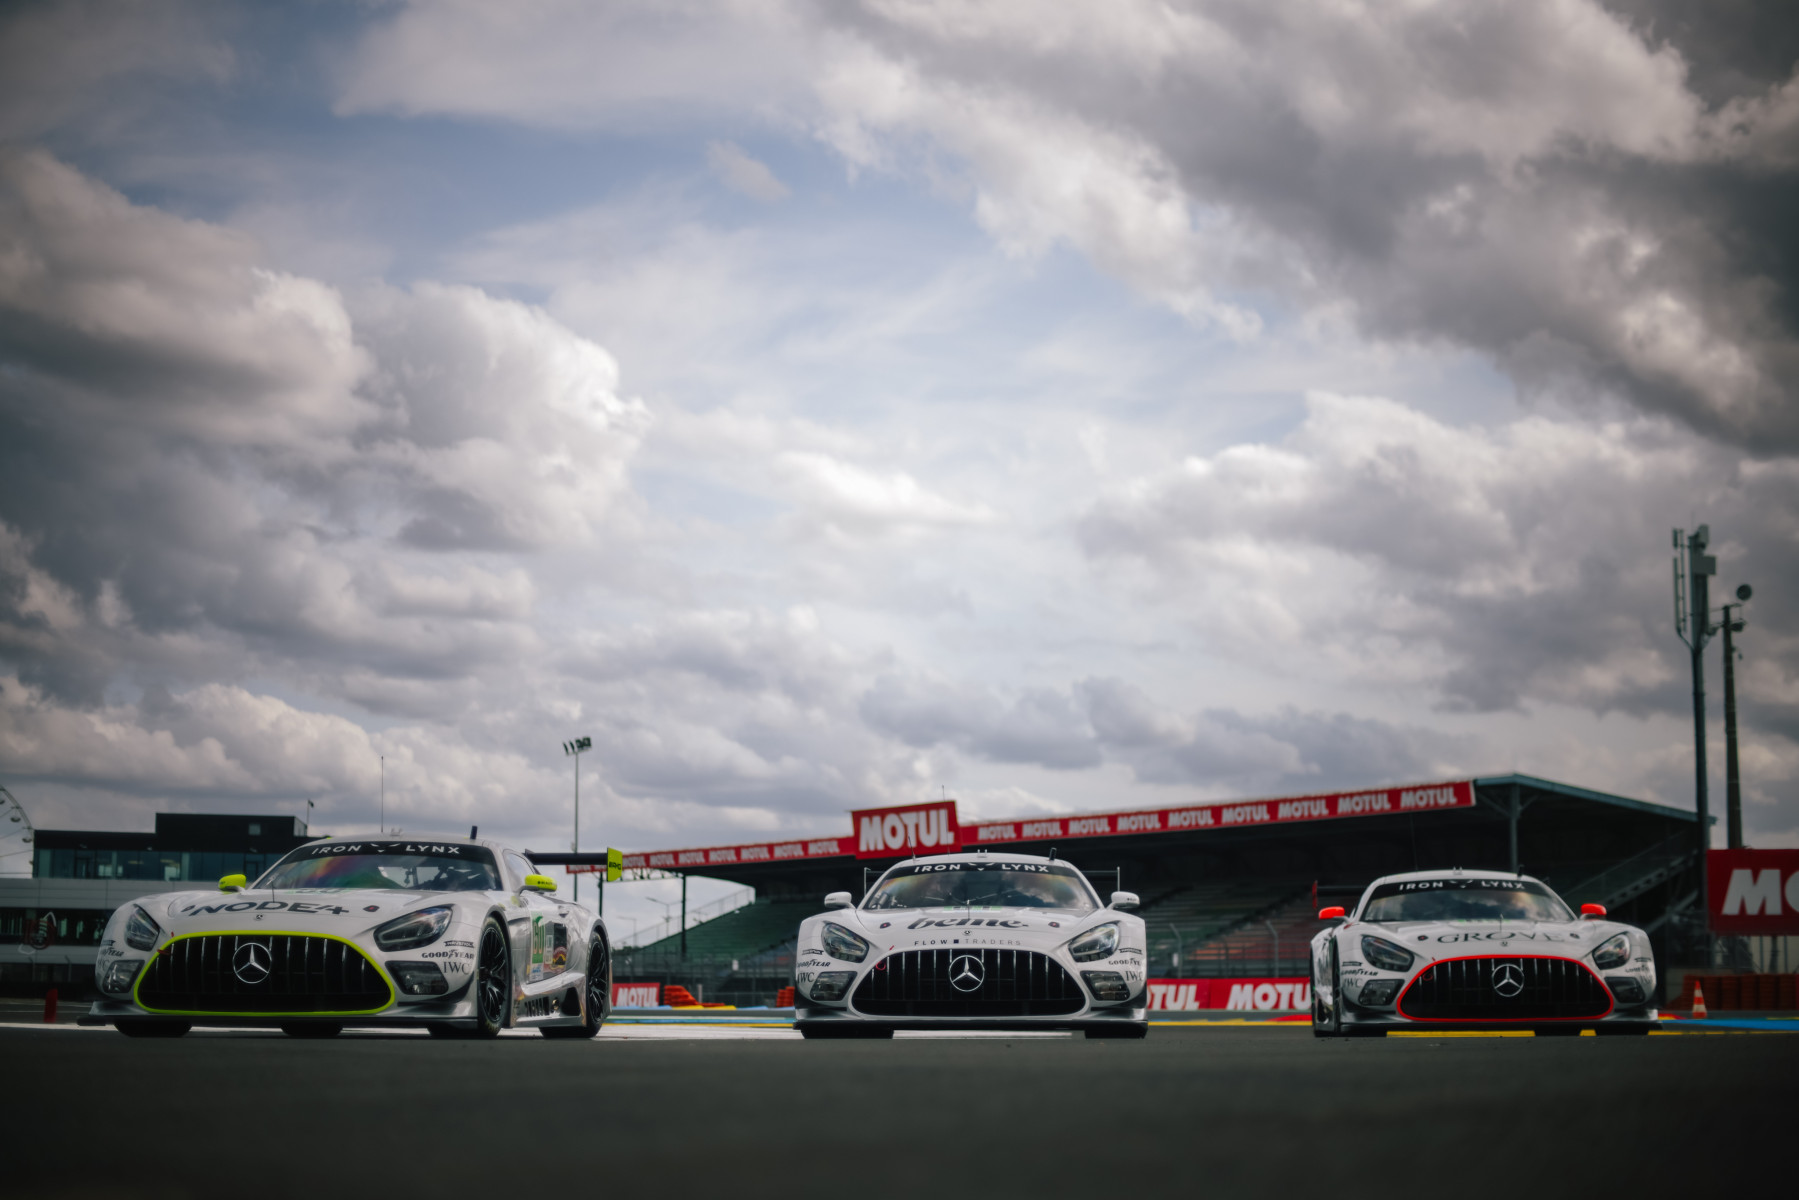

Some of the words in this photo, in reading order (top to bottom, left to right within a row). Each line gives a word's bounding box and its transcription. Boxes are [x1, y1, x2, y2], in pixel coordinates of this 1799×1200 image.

[977, 825, 1016, 840] MOTUL
[1022, 822, 1062, 837] MOTUL
[1068, 818, 1110, 834] MOTUL
[1117, 814, 1161, 831] MOTUL
[1167, 809, 1214, 827] MOTUL
[1222, 805, 1270, 823] MOTUL
[1278, 799, 1329, 818] MOTUL
[1337, 793, 1392, 812] MOTUL
[1401, 787, 1457, 806] MOTUL
[859, 808, 955, 852] MOTUL
[311, 845, 362, 855] IRON
[405, 845, 460, 854] LYNX
[678, 850, 705, 864] MOTUL
[709, 848, 737, 862] MOTUL
[740, 846, 769, 860] MOTUL
[773, 843, 803, 858] MOTUL
[808, 840, 840, 854] MOTUL
[914, 864, 961, 873] IRON
[1001, 863, 1049, 872] LYNX
[1399, 881, 1444, 891] IRON
[1481, 880, 1526, 889] LYNX
[914, 939, 948, 947] FLOW
[1438, 931, 1565, 944] GROVE
[421, 949, 475, 959] GOODYEAR
[443, 961, 470, 975] IWC
[797, 972, 815, 984] IWC
[615, 986, 659, 1007] MOTUL
[1147, 984, 1200, 1010] TUL
